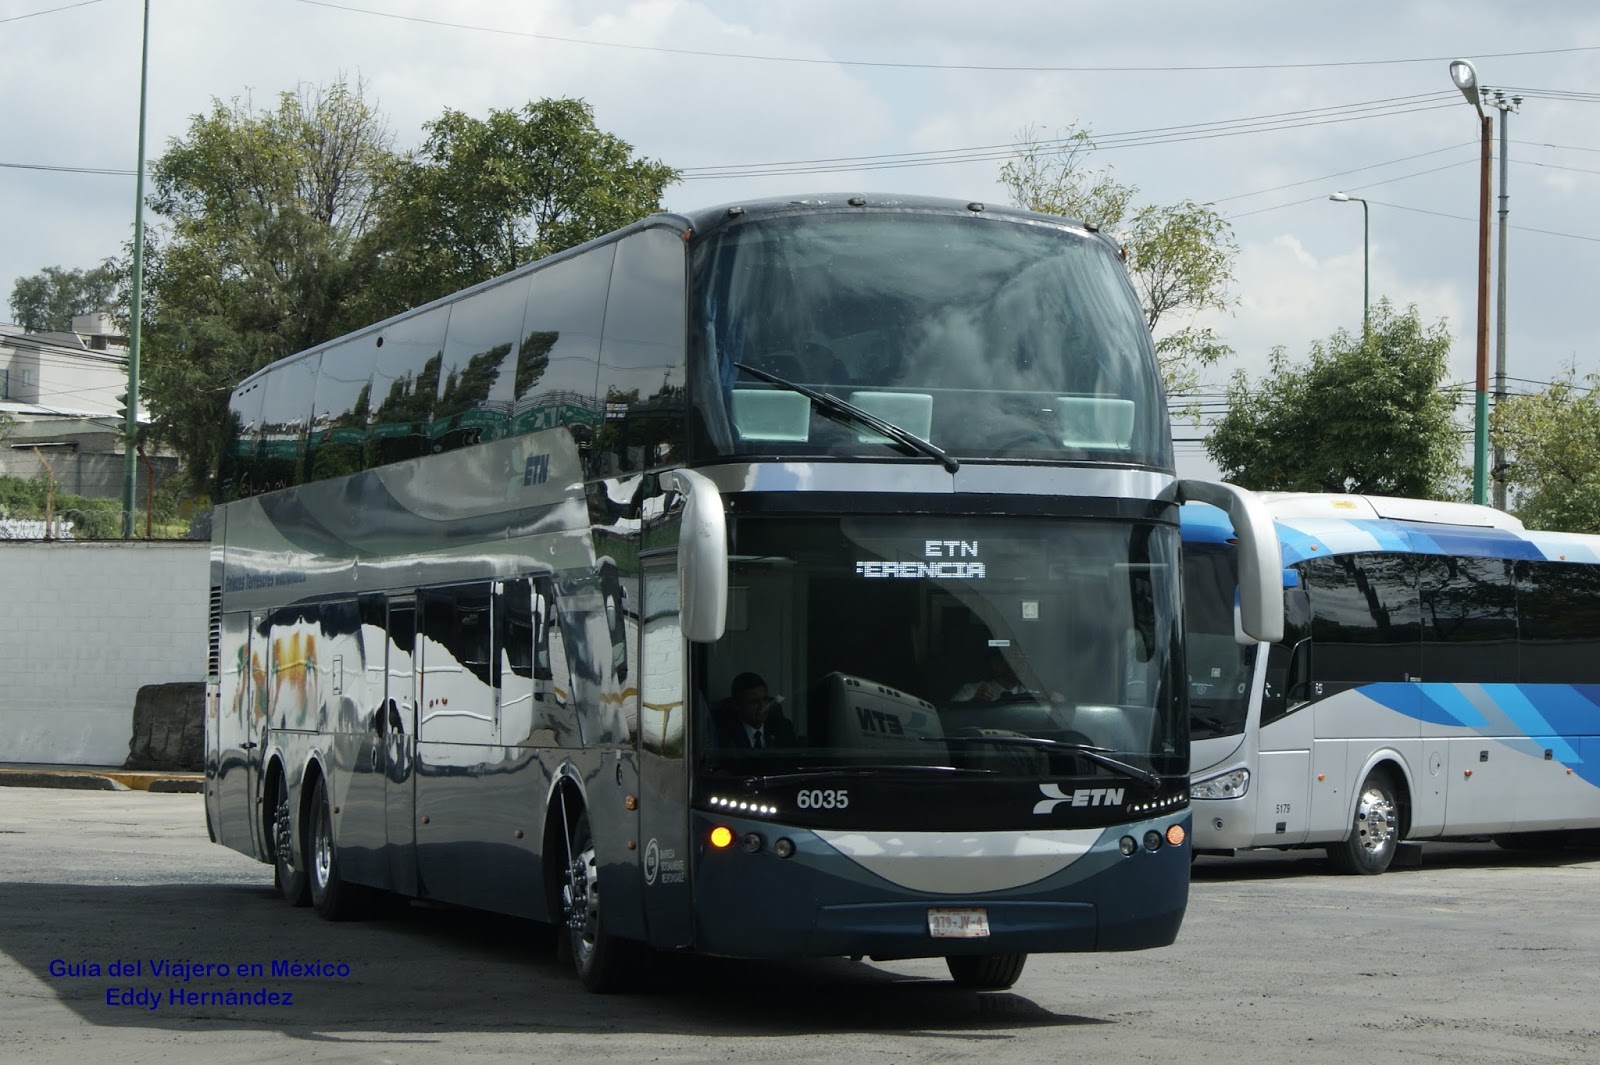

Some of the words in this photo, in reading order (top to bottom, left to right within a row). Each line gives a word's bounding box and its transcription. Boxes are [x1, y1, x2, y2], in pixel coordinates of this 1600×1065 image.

[523, 453, 550, 487] ETN
[925, 540, 978, 557] ETN
[797, 789, 849, 809] 6035
[1071, 788, 1125, 807] ETN
[1276, 803, 1291, 814] 5179
